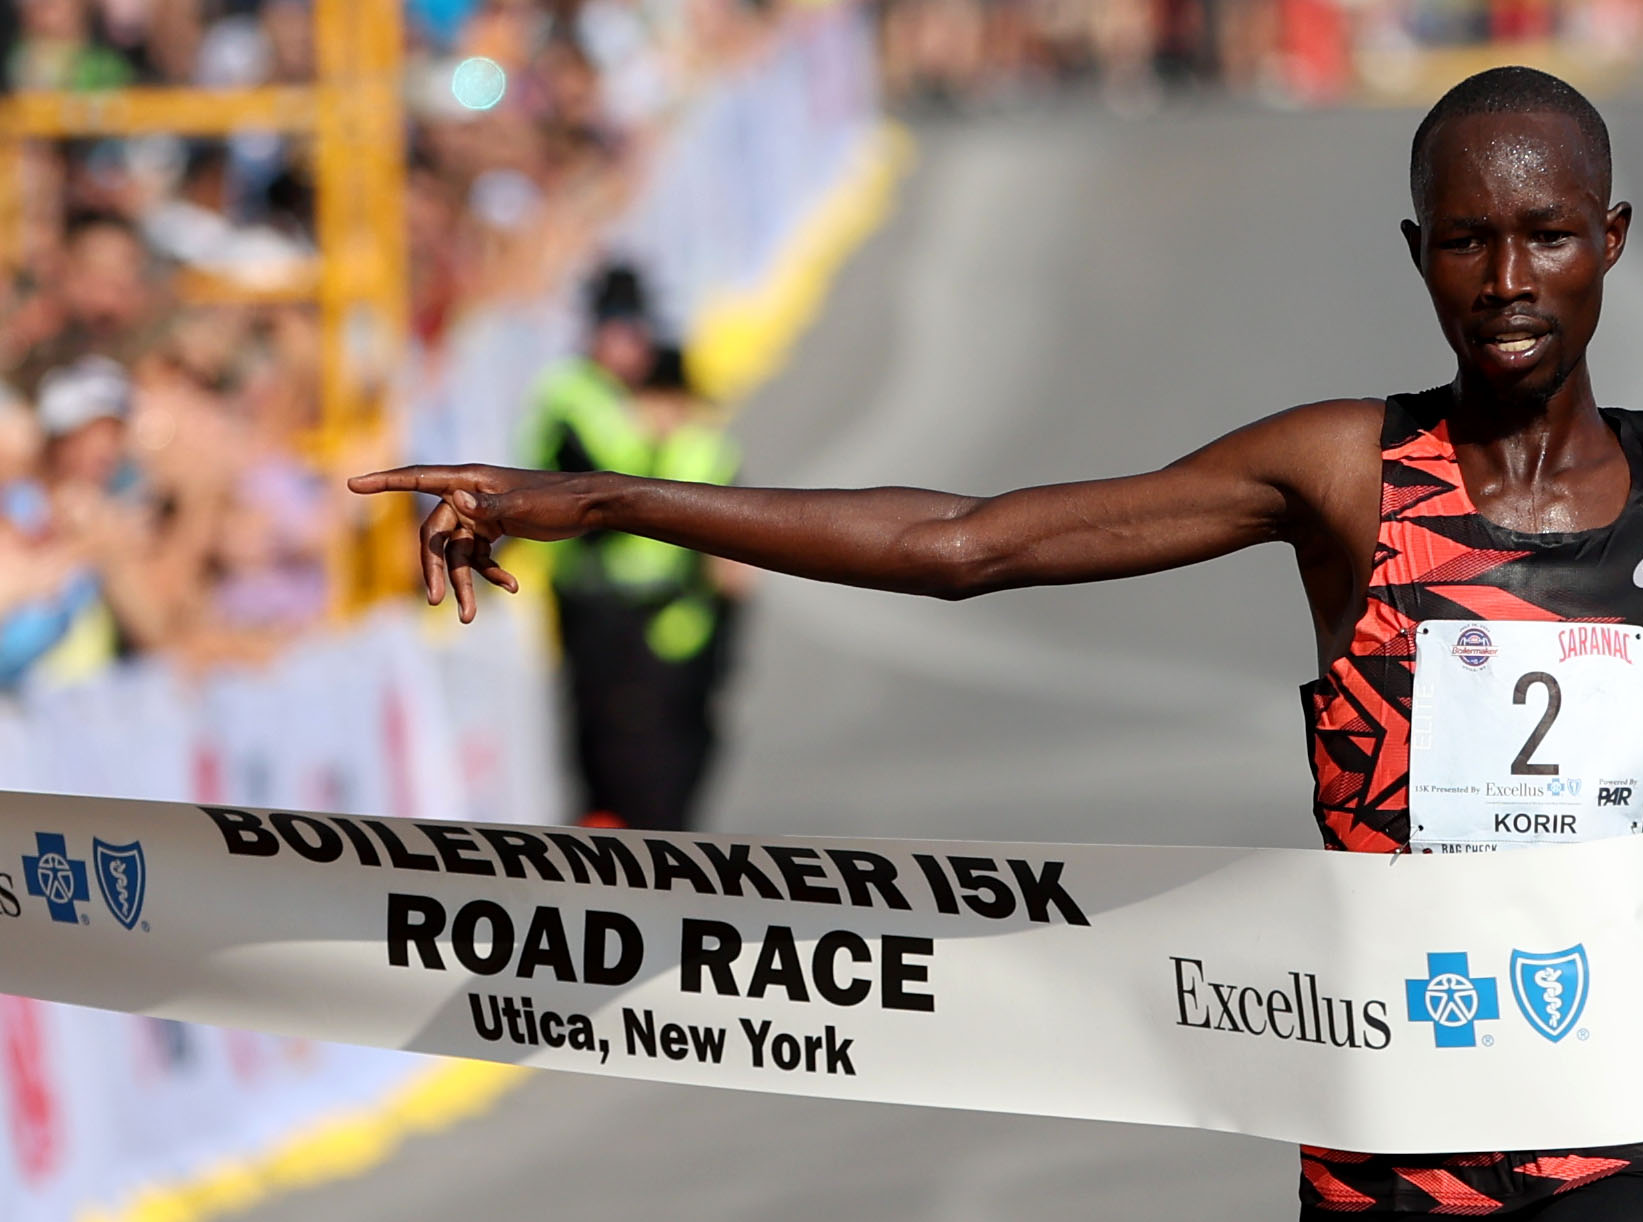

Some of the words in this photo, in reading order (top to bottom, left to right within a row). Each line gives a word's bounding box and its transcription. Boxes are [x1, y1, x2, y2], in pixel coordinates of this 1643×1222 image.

[1558, 626, 1632, 664] SARANAC
[1415, 682, 1436, 750] ELITE
[1510, 671, 1563, 776] 2
[1415, 785, 1429, 793] 15K
[1431, 785, 1469, 793] Presented
[1470, 785, 1480, 794] By
[1486, 782, 1544, 798] Excellus
[1598, 787, 1632, 807] PAR
[1599, 778, 1627, 786] Powered
[1495, 813, 1577, 834] KORIR
[201, 806, 912, 912] BOILERMAKER
[386, 892, 645, 987] ROAD
[680, 917, 936, 1012] RACE
[467, 992, 609, 1064] Utica,
[622, 1008, 726, 1064] New
[738, 1016, 857, 1076] York
[1169, 955, 1392, 1050] Excellus
